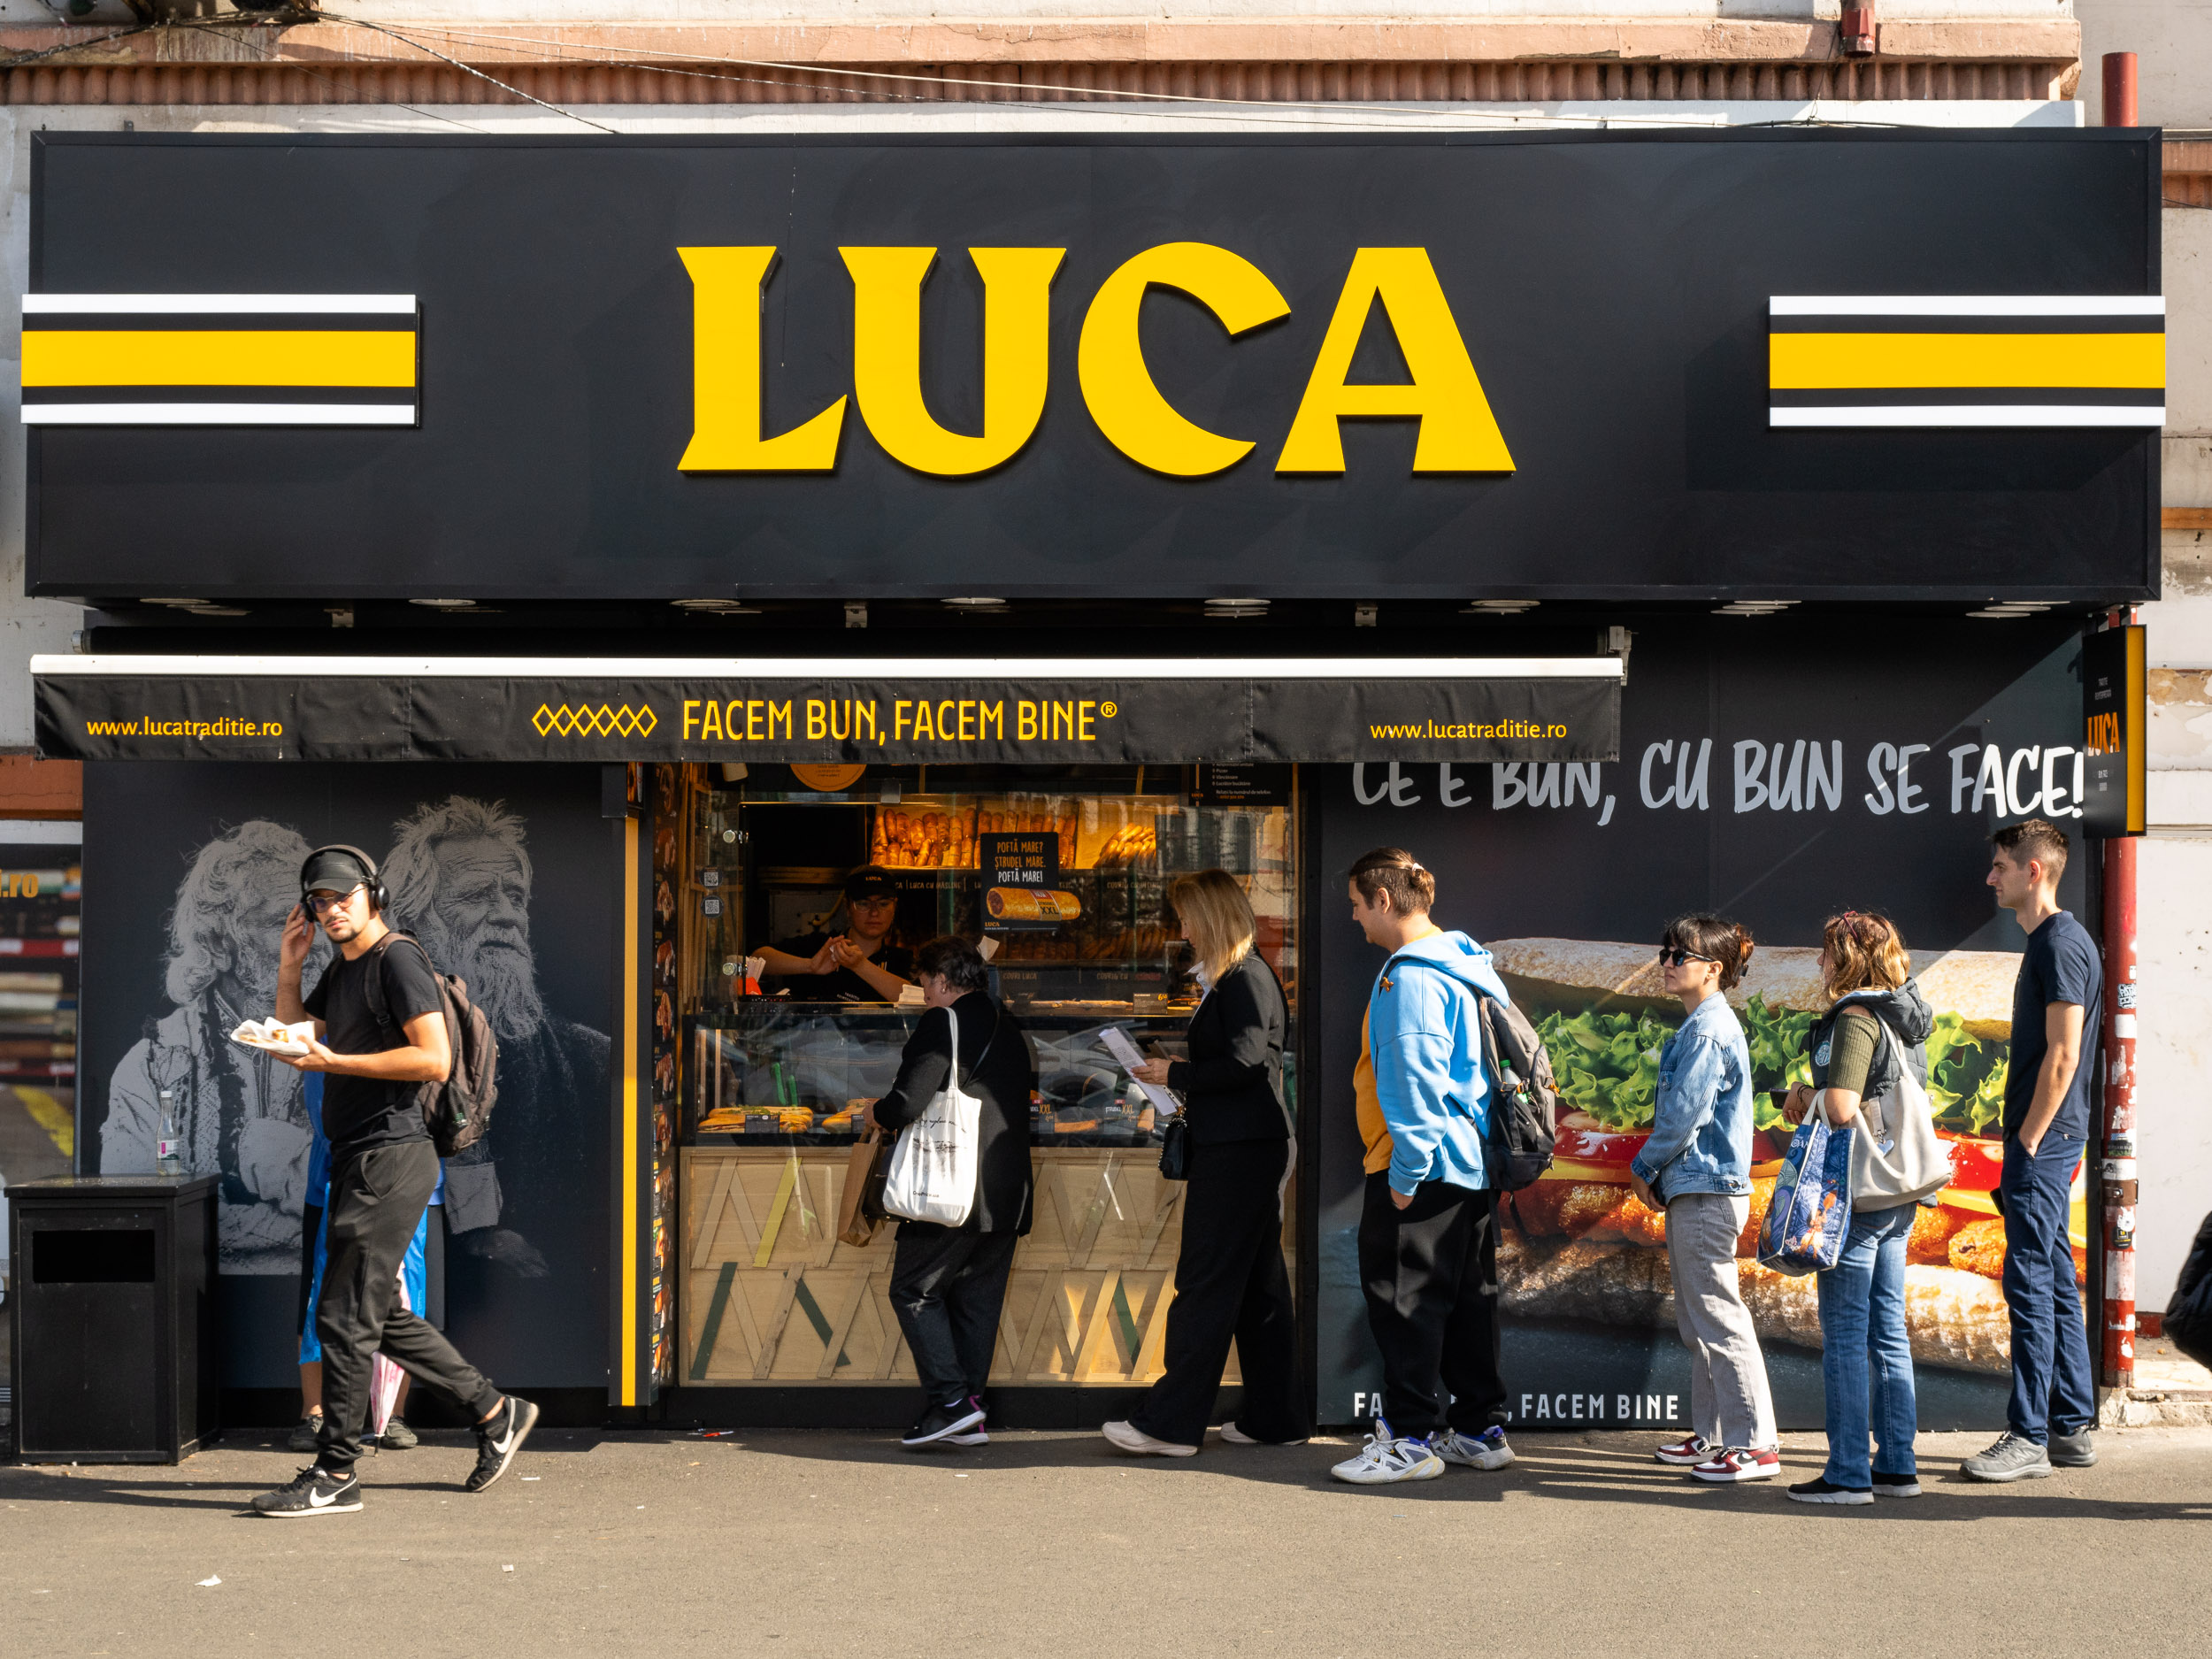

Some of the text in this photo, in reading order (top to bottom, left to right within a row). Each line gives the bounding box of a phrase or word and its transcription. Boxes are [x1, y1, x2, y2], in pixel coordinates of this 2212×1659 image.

[675, 242, 1517, 476] LUCA
[86, 715, 283, 737] www.lucatraditie.ro
[683, 700, 792, 741] FACEM
[806, 699, 886, 747] BUN,
[895, 700, 1003, 741] FACEM
[1370, 718, 1567, 739] www.lucatraditie.ro
[2087, 711, 2121, 757] LUCA
[1492, 762, 1617, 826] BUN,
[1640, 738, 1713, 811] CU
[1732, 739, 1843, 814] BUN
[1864, 741, 1931, 816] SE
[1947, 742, 2085, 819] FACE!
[996, 838, 1018, 853] POFTĂ
[0, 868, 39, 898] .ro
[998, 868, 1043, 883] POFTĂ MARE!
[1040, 906, 1059, 915] XXL
[1039, 1104, 1052, 1115] XXL
[1122, 1104, 1134, 1115] XXL
[1521, 1394, 1604, 1419] FACEM
[1617, 1394, 1678, 1420] BINE
